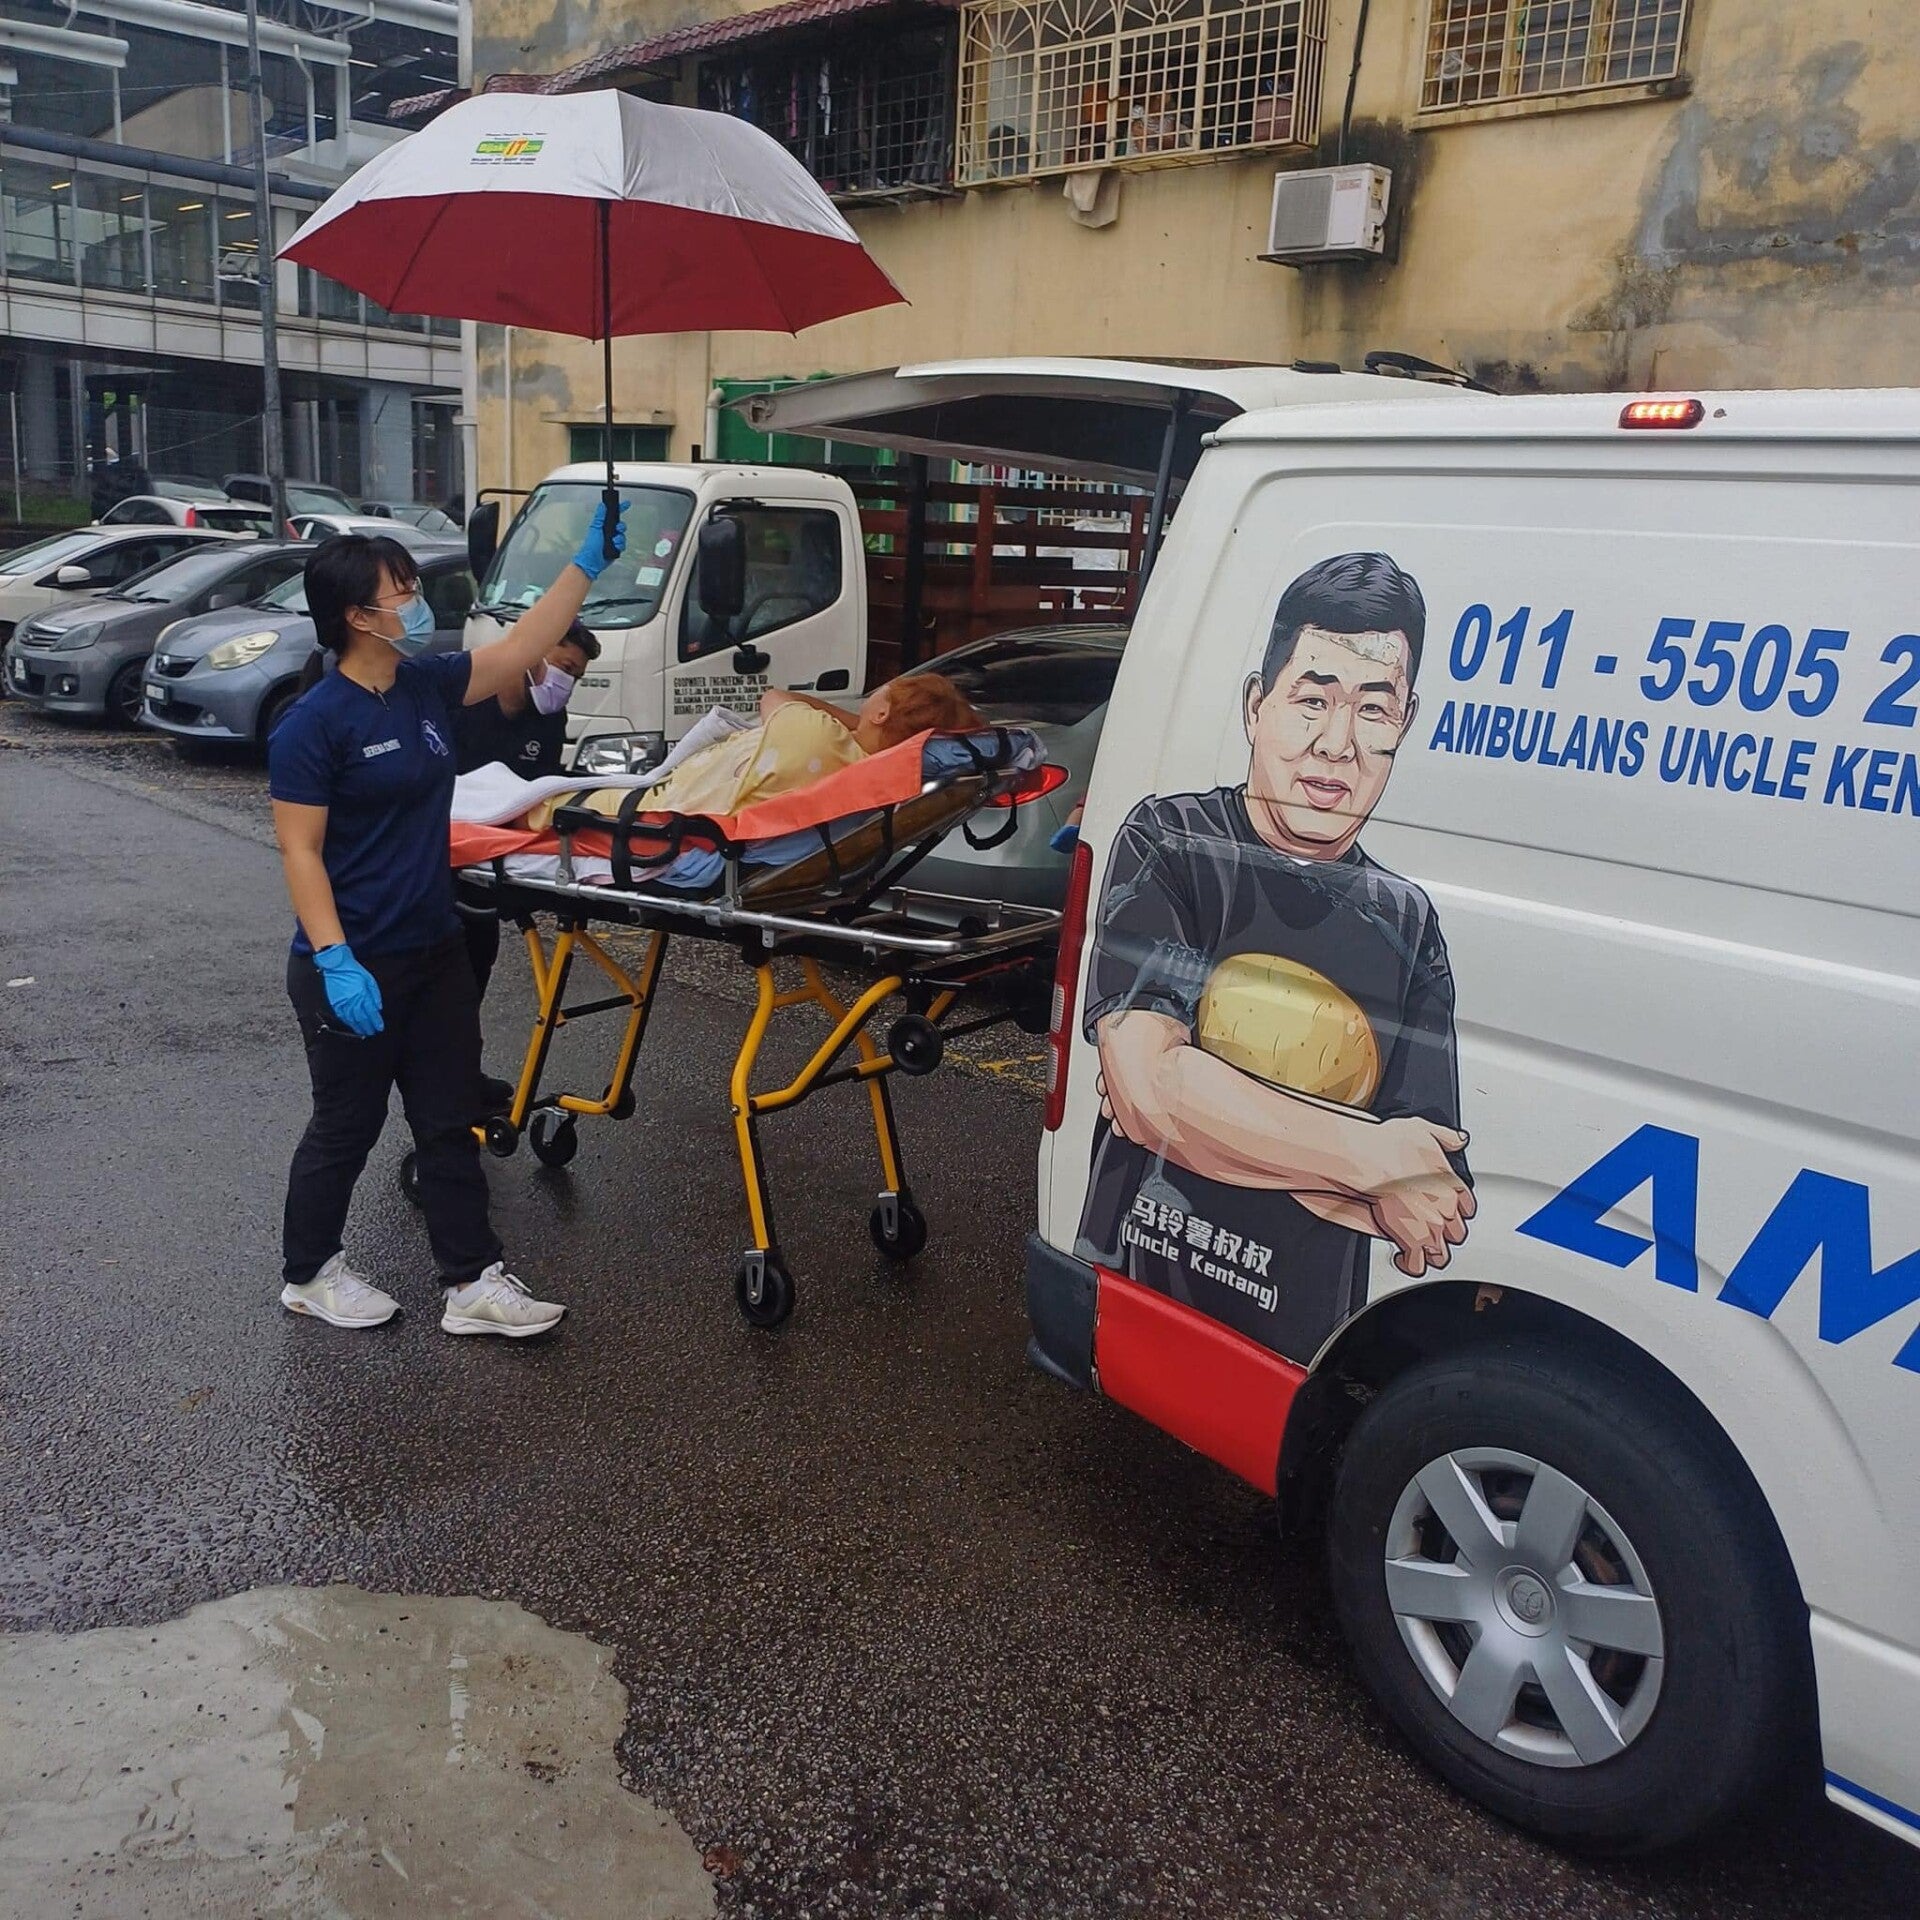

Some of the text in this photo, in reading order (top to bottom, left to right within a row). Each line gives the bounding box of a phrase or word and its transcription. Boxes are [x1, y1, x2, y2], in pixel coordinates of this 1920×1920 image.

[1449, 603, 1575, 689] 011
[1639, 617, 1850, 717] 5505
[1863, 634, 1920, 727] 2
[1429, 701, 1920, 817] AMBULANS UNCLE KEN
[1121, 1219, 1279, 1313] (Uncle Kentang)
[1131, 1194, 1273, 1277] 马铃薯叔叔
[1515, 1123, 1920, 1375] AM
